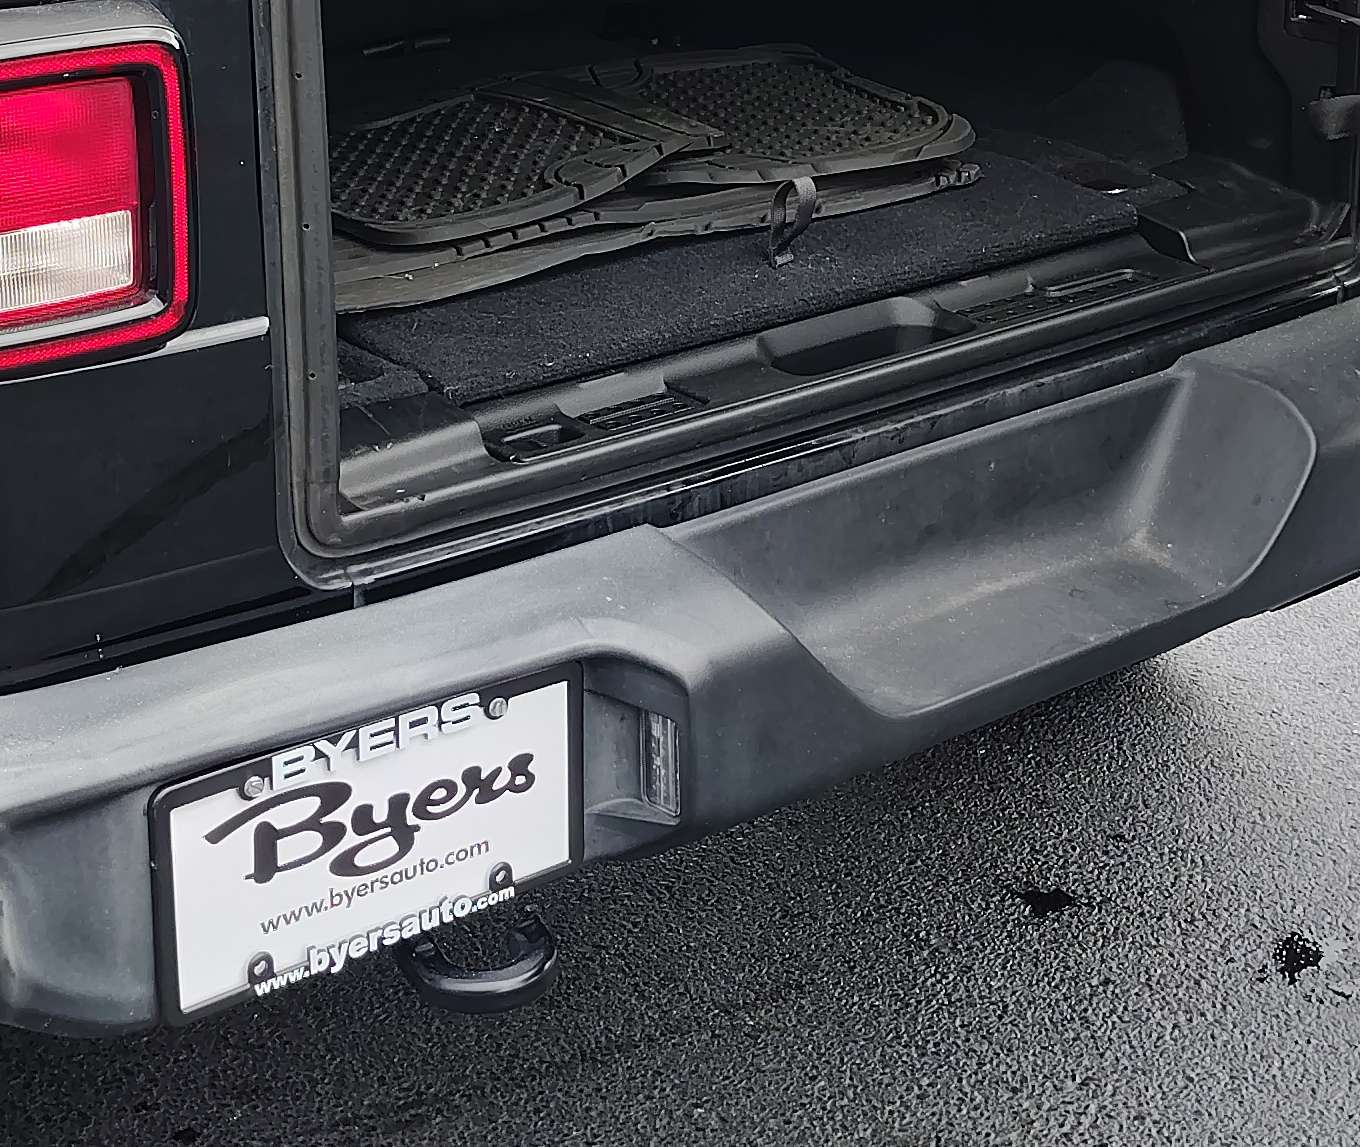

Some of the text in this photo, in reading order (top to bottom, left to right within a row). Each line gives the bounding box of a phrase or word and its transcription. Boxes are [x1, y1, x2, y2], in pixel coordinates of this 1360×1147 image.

[270, 691, 482, 791] BYERS
[202, 751, 537, 884] Byers
[254, 883, 515, 997] www.byersauto.com
[260, 838, 491, 935] www.byersauto.com
